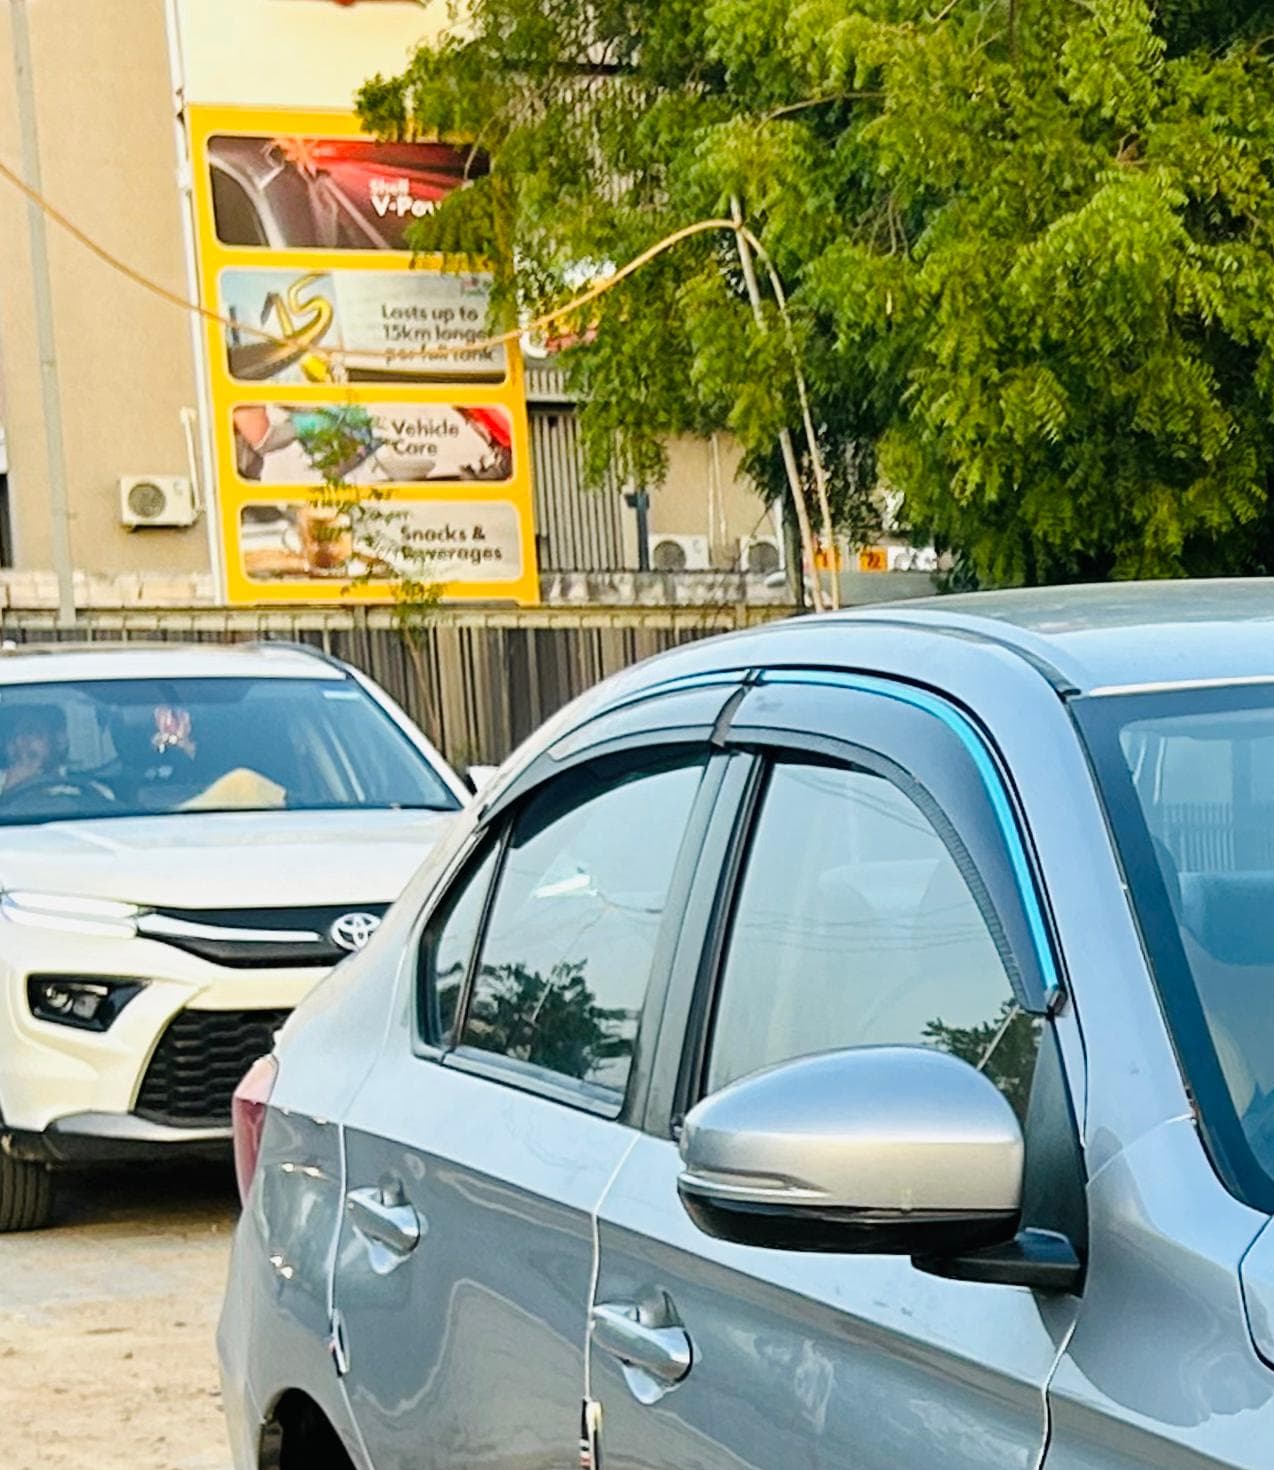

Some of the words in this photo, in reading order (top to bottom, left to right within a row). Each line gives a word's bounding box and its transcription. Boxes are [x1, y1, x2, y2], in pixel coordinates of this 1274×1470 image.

[371, 194, 442, 217] V-Po
[382, 304, 428, 320] Lasts
[431, 308, 455, 324] up
[459, 305, 479, 320] to
[383, 323, 431, 341] 15km
[435, 324, 487, 344] longe
[391, 418, 460, 435] Vehicle
[392, 440, 437, 455] Care
[401, 523, 466, 541] Snacks
[472, 525, 486, 540] &
